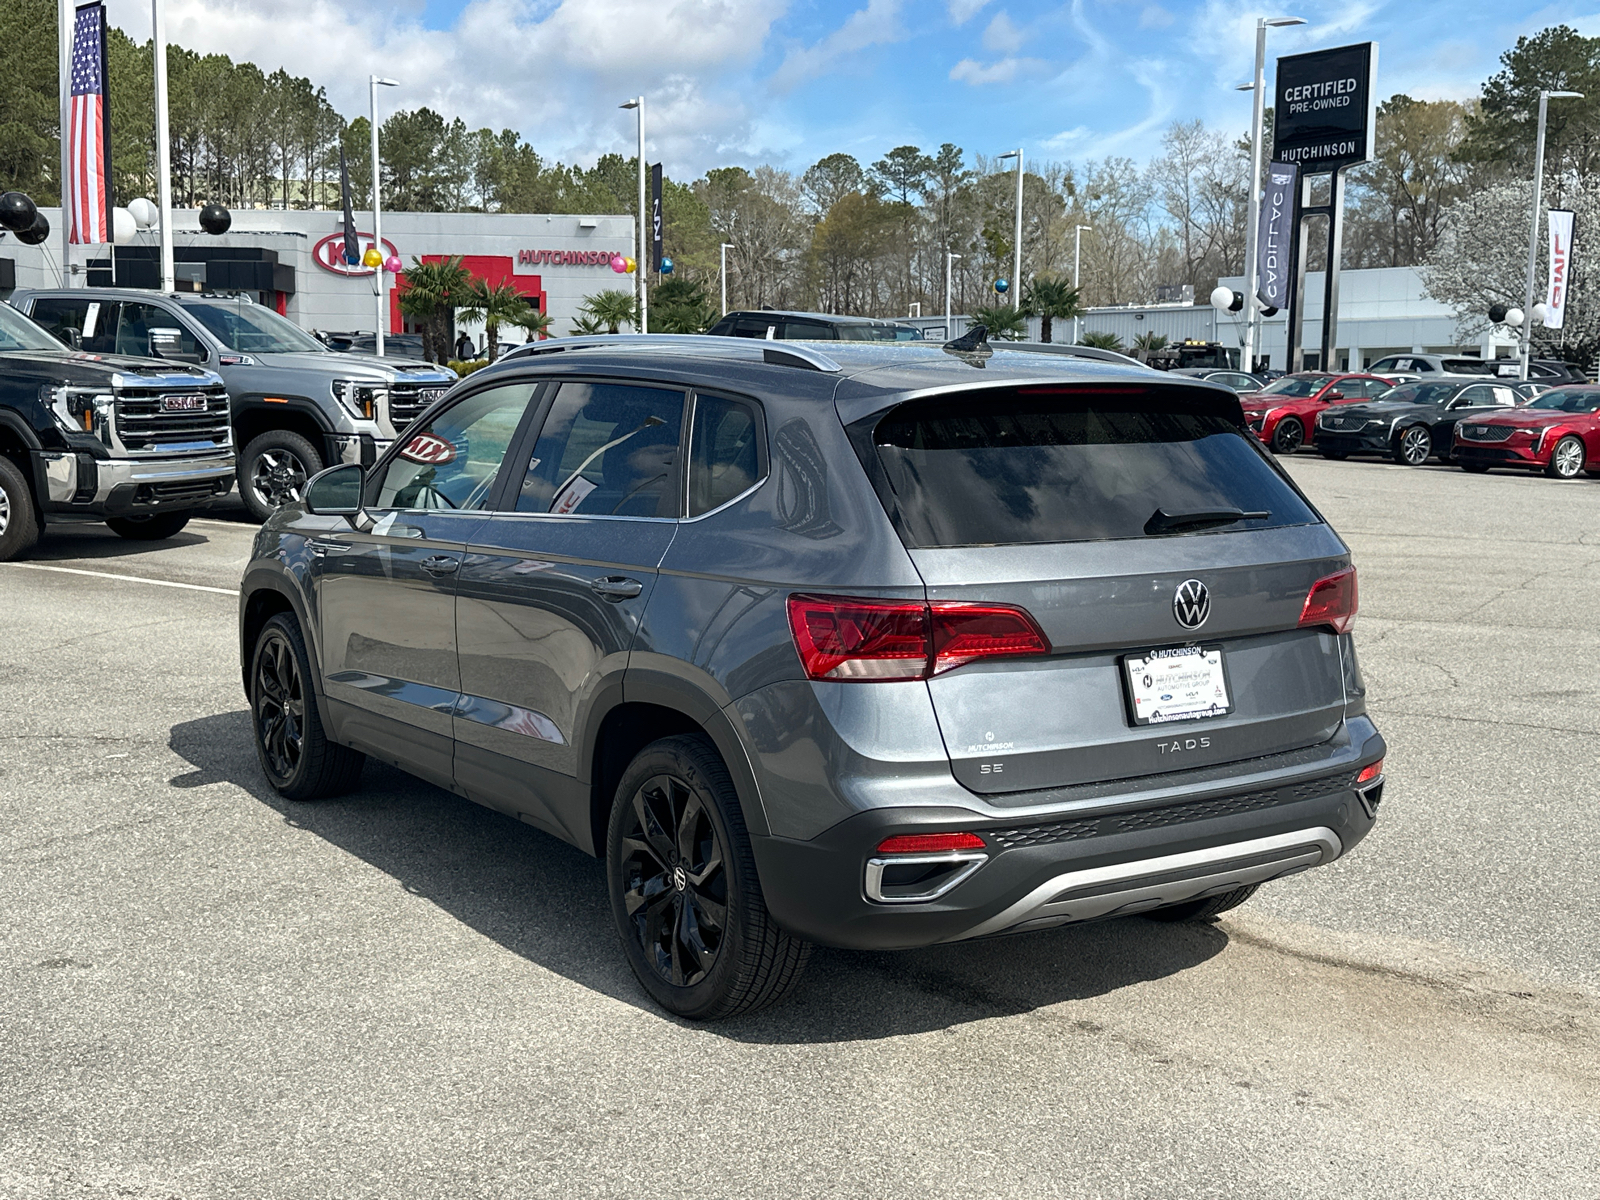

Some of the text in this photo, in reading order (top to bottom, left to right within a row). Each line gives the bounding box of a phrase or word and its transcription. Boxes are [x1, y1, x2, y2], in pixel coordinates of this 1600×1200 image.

[1285, 78, 1357, 102] CERTIFIED
[1289, 95, 1350, 114] PRE-OWNED
[1281, 141, 1356, 161] HUTCHINSON
[1267, 192, 1284, 298] CADILLAC
[165, 396, 207, 410] GMC
[1158, 646, 1202, 659] HUTCHINSON
[1157, 680, 1210, 692] AUTOMOTIVE GROUP
[967, 742, 1015, 752] HUTCHINSON
[1157, 736, 1211, 755] TAOS
[980, 763, 1004, 774] SE
